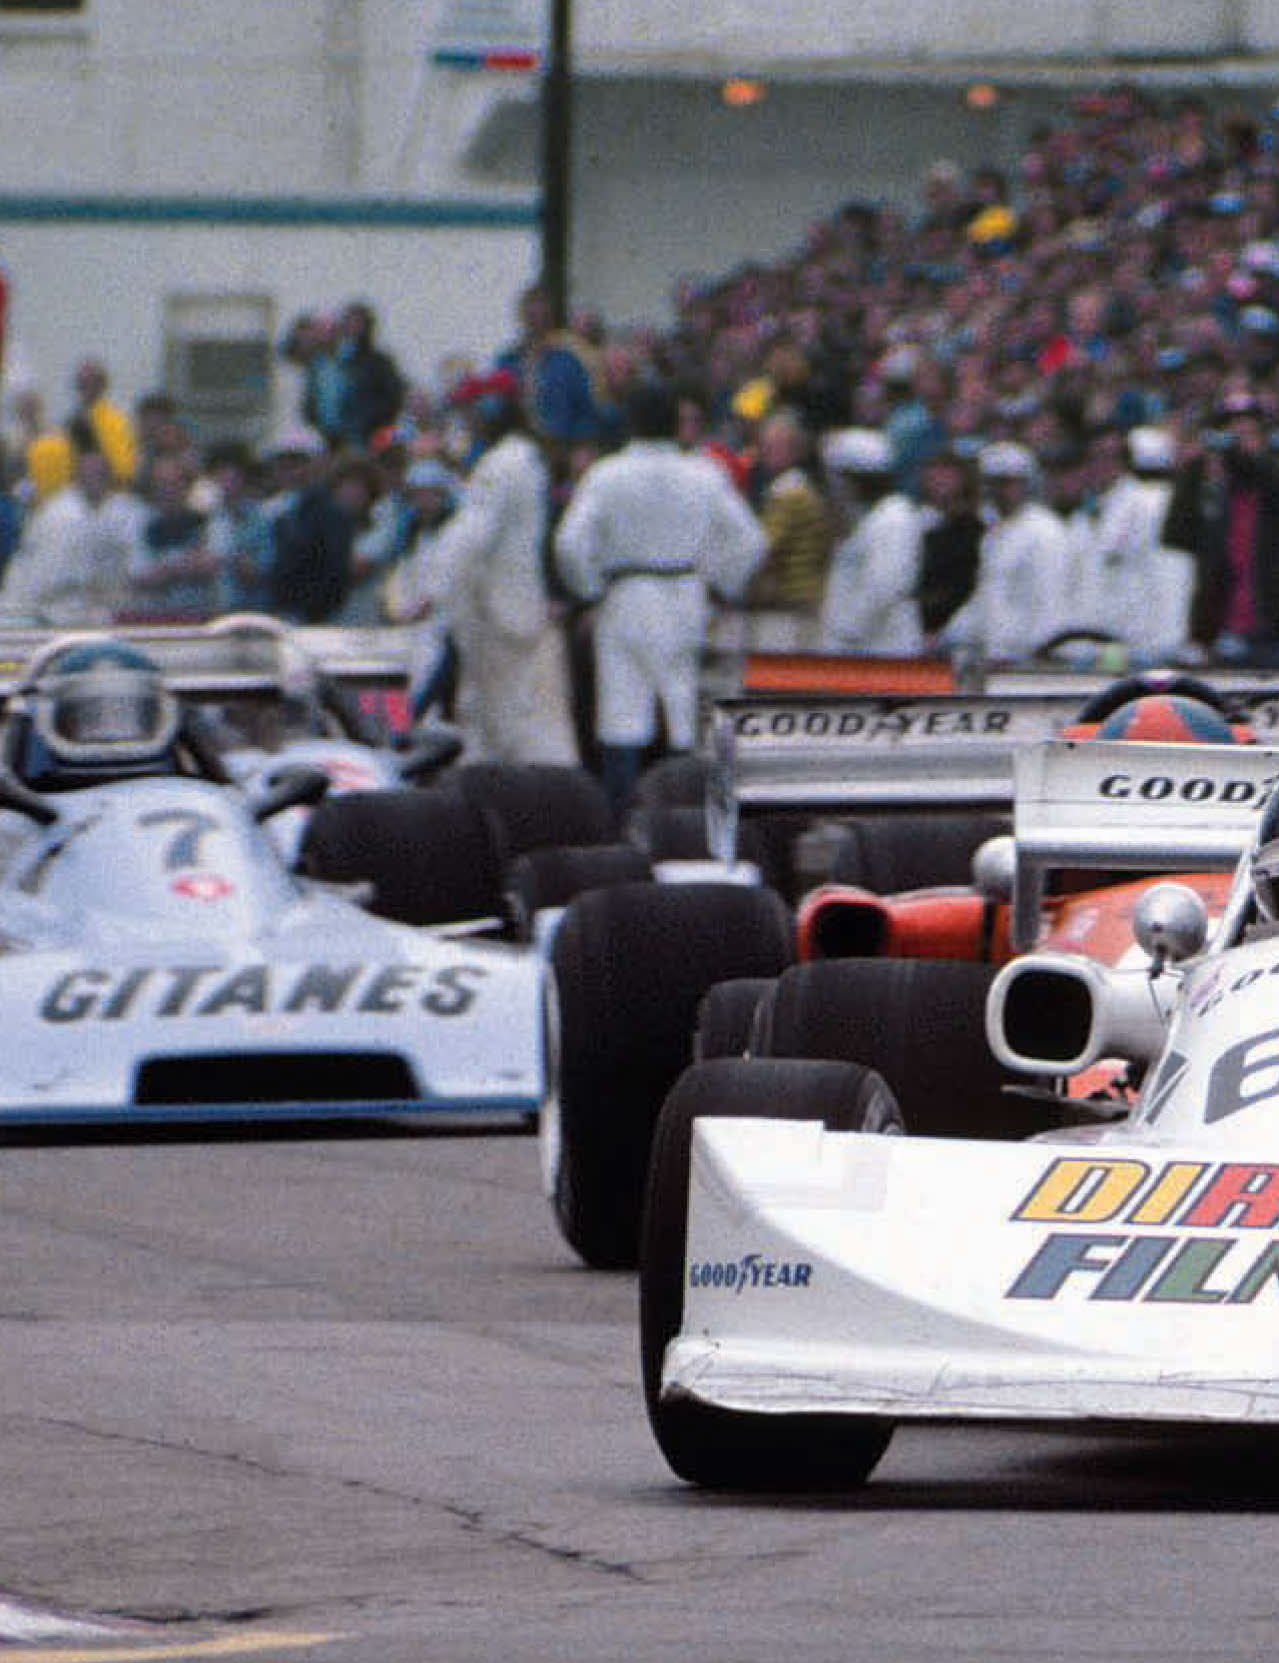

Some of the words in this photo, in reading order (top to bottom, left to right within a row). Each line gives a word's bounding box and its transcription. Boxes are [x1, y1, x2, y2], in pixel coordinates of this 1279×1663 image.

[1098, 772, 1262, 804] GOOD
[39, 964, 486, 1022] GITANES
[688, 1253, 813, 1295] GOODYEAR
